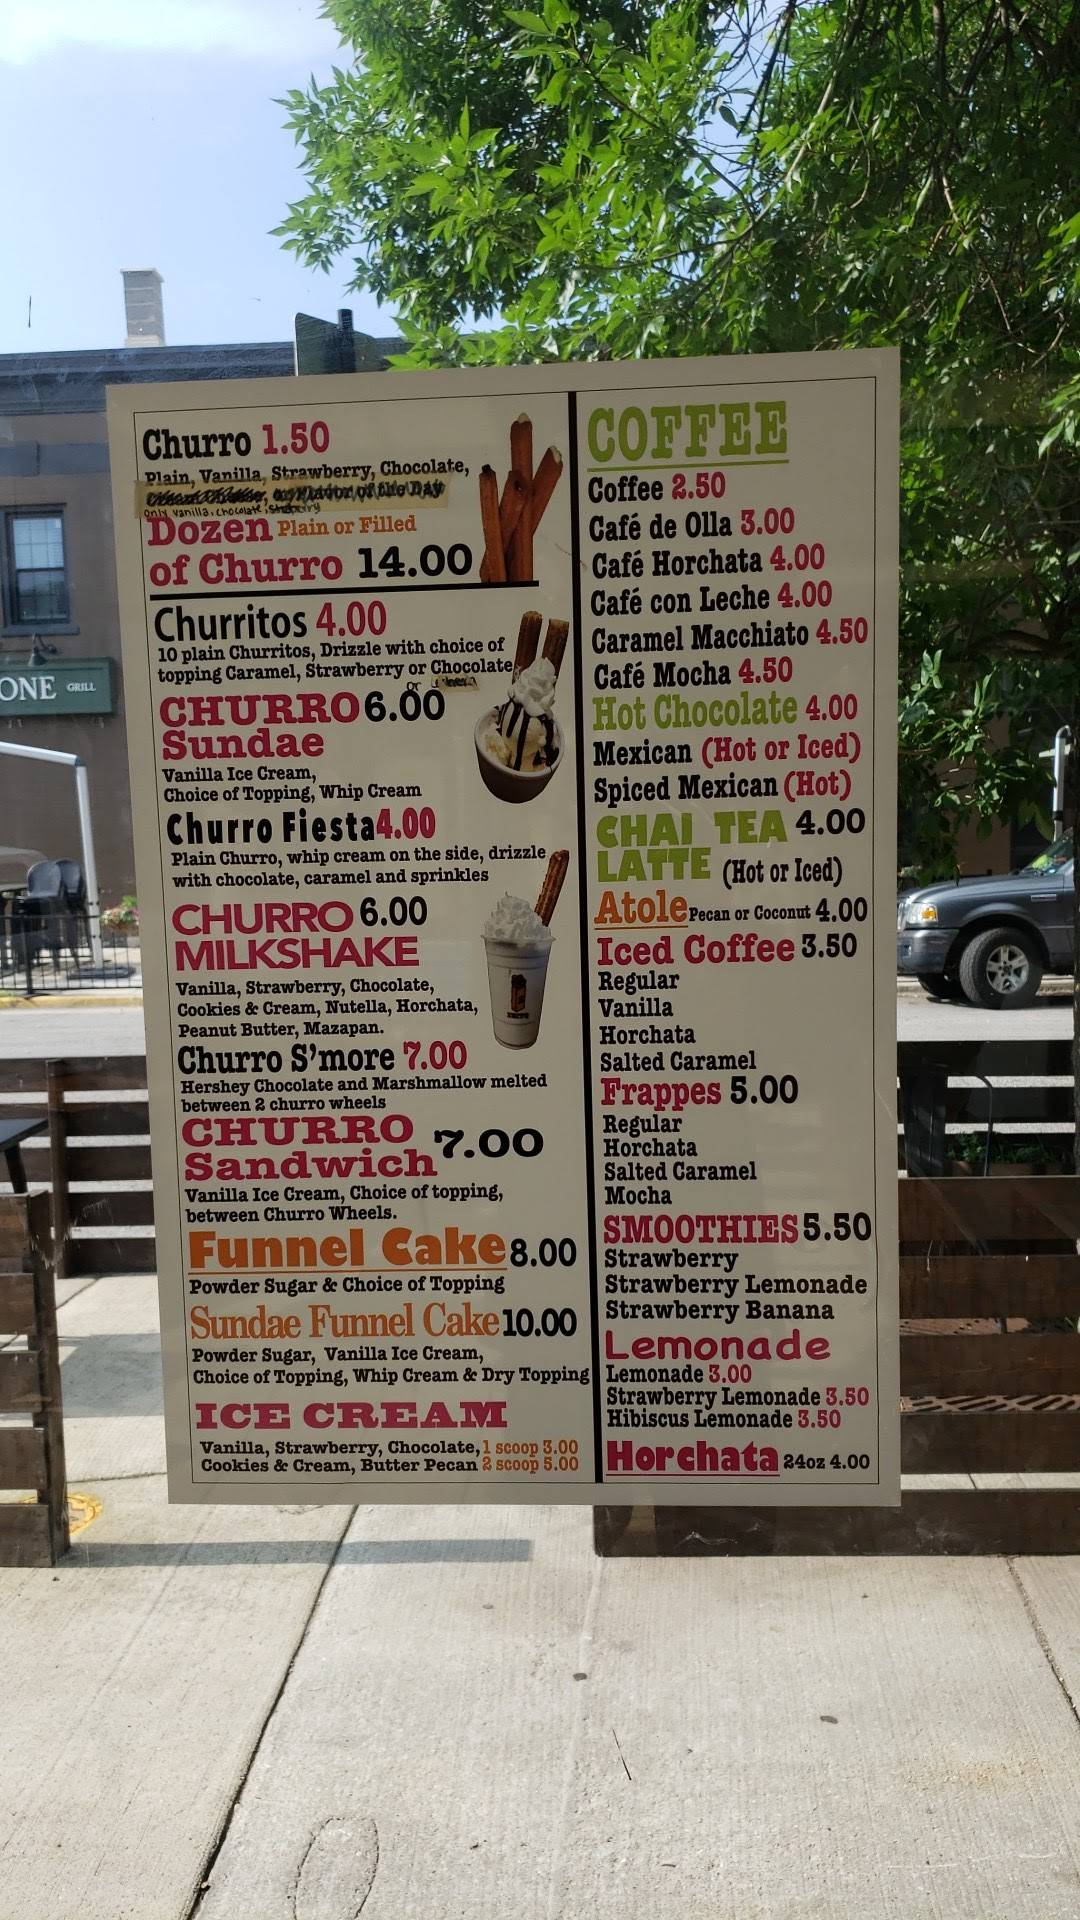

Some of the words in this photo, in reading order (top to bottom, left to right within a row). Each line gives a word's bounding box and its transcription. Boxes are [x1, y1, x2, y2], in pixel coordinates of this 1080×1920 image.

[142, 428, 251, 460] Churro
[262, 421, 330, 455] 1.50
[588, 401, 788, 462] COFFEE
[145, 471, 195, 487] Plain,
[271, 461, 376, 482] Strawberry,
[380, 458, 470, 477] Chocolate,
[588, 475, 663, 503] Coffee
[672, 471, 726, 499] 2.50
[147, 516, 273, 546] Dozen
[278, 520, 330, 537] Plain
[334, 519, 355, 534] or
[359, 515, 416, 533] Filled
[590, 513, 641, 542] Café
[649, 513, 677, 539] de
[685, 511, 732, 538] Olla
[741, 507, 795, 535] 3.00
[150, 556, 189, 586] of
[198, 553, 343, 585] Churro
[358, 543, 473, 579] 14.00
[592, 550, 644, 579] Café
[652, 549, 763, 576] Horchata
[770, 543, 825, 571] 4.00
[155, 605, 307, 642] Churritos
[316, 600, 388, 637] 4.00
[592, 626, 683, 654] Caramel
[691, 621, 809, 649] Macchiato
[816, 617, 869, 644] 4.50
[158, 647, 177, 662] 10
[181, 646, 225, 664] plain
[229, 643, 316, 662] Churritos,
[320, 641, 382, 658] Drizzle
[385, 639, 424, 656] with
[429, 639, 482, 653] choice
[481, 636, 505, 653] of
[158, 665, 222, 685] topping
[225, 664, 301, 682] Caramel,
[305, 661, 404, 679] Strawberry
[408, 662, 427, 675] or
[430, 657, 513, 675] Chocolate
[67, 683, 96, 692] GRILL
[160, 692, 360, 727] CHURRO
[364, 689, 445, 723] 6.00
[592, 696, 646, 730] Hot
[654, 691, 798, 729] Chocolate
[806, 693, 858, 721] 4.00
[162, 728, 324, 761] Sundae
[594, 776, 670, 808] Spiced
[678, 772, 778, 800] Mexican
[784, 769, 851, 802] (Hot)
[167, 811, 273, 845] Churro
[283, 808, 374, 842] Fiesta
[376, 806, 436, 839] 4.00
[596, 813, 692, 849] CHAI
[713, 810, 788, 844] TEA
[796, 808, 865, 835] 4.00
[173, 873, 212, 888] with
[216, 871, 300, 888] chocolate,
[304, 870, 371, 885] caramel
[376, 869, 407, 884] and
[411, 868, 489, 885] sprinkles
[597, 847, 711, 882] LATTE
[723, 859, 764, 889] (Hot
[770, 862, 789, 882] or
[795, 856, 842, 887] Iced)
[172, 901, 354, 936] CHURRO
[360, 896, 428, 927] 6.00
[594, 889, 688, 924] Atole
[689, 907, 730, 922] Pecan
[734, 907, 749, 921] or
[754, 904, 811, 920] Coconut
[815, 897, 868, 922] 4.00
[175, 936, 420, 971] MILKSHAKE
[597, 936, 674, 966] Iced
[684, 933, 795, 964] Coffee
[802, 933, 857, 958] 3.50
[598, 970, 679, 995] Regular
[177, 1002, 241, 1018] Cookies
[245, 1002, 258, 1016] &
[263, 1000, 321, 1018] Cream,
[325, 1000, 392, 1016] Nutella,
[396, 997, 478, 1016] Horchata,
[598, 997, 673, 1018] Vanilla
[179, 1023, 236, 1038] Peanut
[241, 1021, 299, 1039] Butter,
[303, 1021, 383, 1038] Mazapan.
[599, 1025, 696, 1045] Horchata
[177, 1045, 283, 1075] Churro
[403, 1040, 467, 1071] 7.00
[600, 1051, 664, 1072] Salted
[671, 1050, 756, 1071] Caramel
[182, 1079, 248, 1095] Hershey
[253, 1078, 333, 1094] Chocolate
[337, 1077, 368, 1092] and
[372, 1075, 487, 1092] Marshmallow
[490, 1073, 547, 1088] melted
[601, 1077, 721, 1111] Frappes
[731, 1075, 799, 1105] 5.00
[182, 1098, 251, 1113] between
[255, 1098, 265, 1112] 2
[270, 1097, 326, 1111] churro
[329, 1096, 386, 1111] wheels
[604, 1214, 798, 1244] SMOOTHIES
[803, 1212, 871, 1241] 5.50
[188, 1228, 365, 1269] Funnel
[382, 1227, 507, 1267] Cake
[510, 1238, 577, 1267] 8.00
[605, 1275, 739, 1298] Strawberry
[745, 1275, 867, 1294] Lemonade
[606, 1329, 831, 1361] Lemonade
[193, 1369, 249, 1385] Choice
[254, 1369, 272, 1384] of
[273, 1369, 349, 1386] Topping,
[353, 1369, 399, 1385] Whip
[403, 1368, 458, 1383] Cream
[463, 1369, 478, 1383] &
[482, 1368, 515, 1385] Dry
[519, 1368, 591, 1385] Topping
[606, 1364, 704, 1383] Lemonade
[709, 1364, 752, 1383] 3.00
[607, 1387, 717, 1410] Strawberry
[722, 1387, 821, 1406] Lemonade
[826, 1387, 869, 1406] 3.50
[196, 1402, 290, 1430] ICE
[303, 1401, 508, 1429] CREAM
[608, 1409, 690, 1428] Hibiscus
[694, 1410, 793, 1428] Lemonade
[797, 1410, 841, 1428] 3.50
[200, 1441, 270, 1457] Vanilla,
[275, 1440, 383, 1457] Strawberry,
[387, 1440, 480, 1457] Chocolate,
[482, 1440, 491, 1454] 1
[496, 1442, 538, 1458] scoop
[543, 1440, 579, 1455] 3.00
[607, 1441, 779, 1471] Horchata
[783, 1455, 825, 1469] 24oz
[830, 1454, 870, 1469] 4.00
[202, 1459, 269, 1473] Cookies
[273, 1459, 288, 1472] &
[292, 1459, 356, 1475] Cream,
[360, 1459, 421, 1472] Butter
[424, 1458, 478, 1472] Pecan
[482, 1457, 491, 1472] 2
[496, 1459, 538, 1475] scoop
[543, 1457, 579, 1472] 5.00
